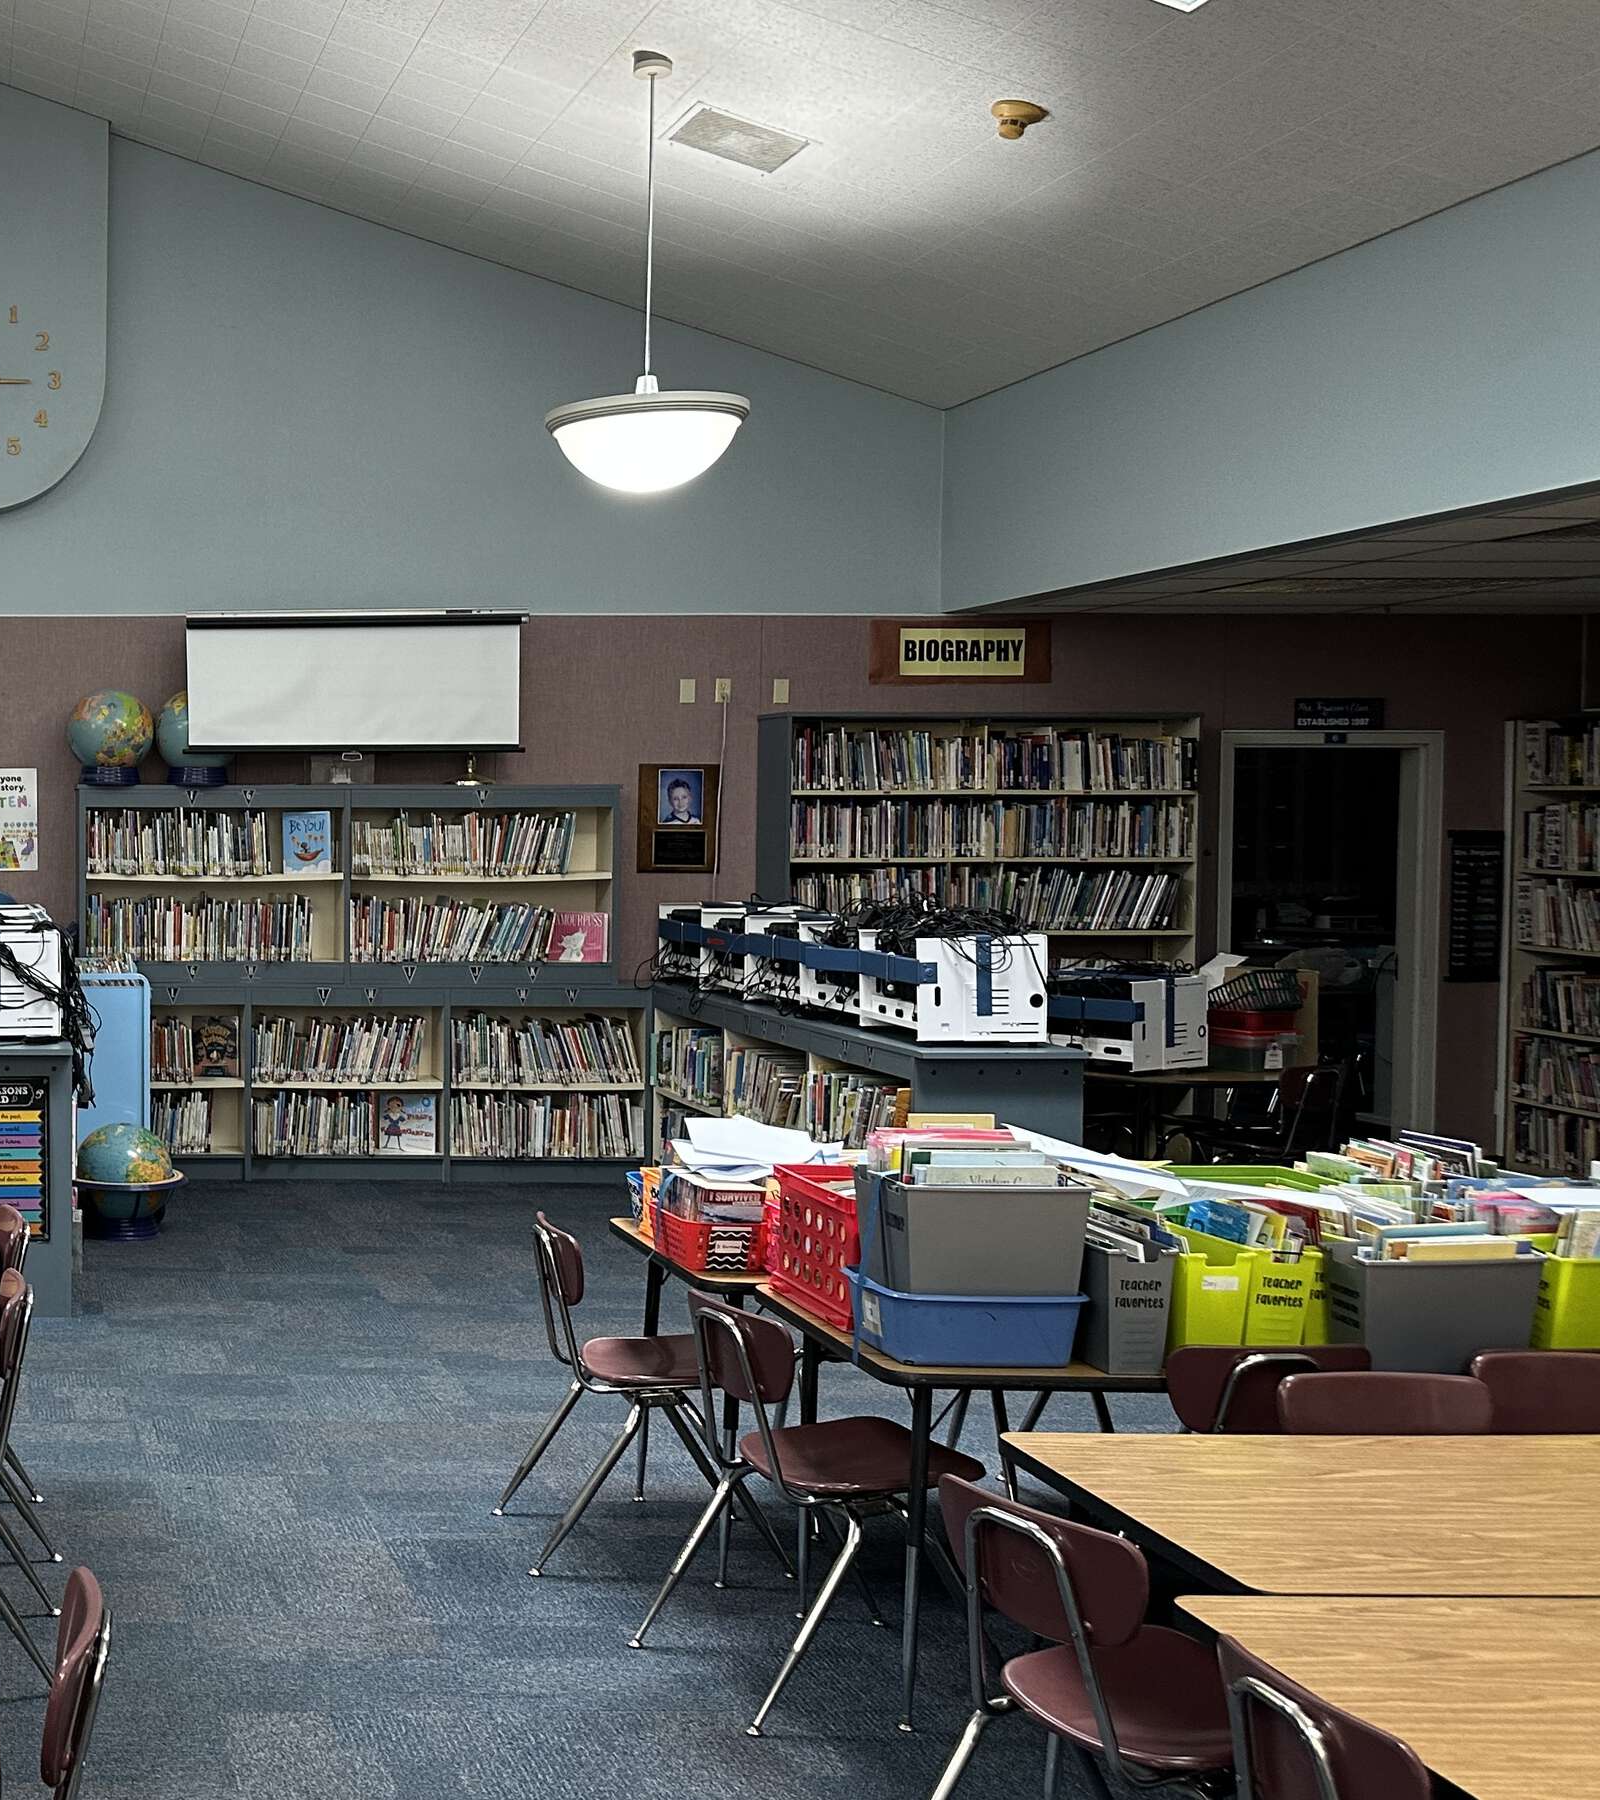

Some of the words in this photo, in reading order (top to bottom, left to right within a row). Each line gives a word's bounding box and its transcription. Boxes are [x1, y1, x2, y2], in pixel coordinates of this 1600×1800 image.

[8, 305, 19, 324] 1
[34, 331, 50, 352] 2
[47, 370, 62, 390] 3
[33, 409, 49, 428] 4
[6, 436, 22, 455] 5
[904, 639, 1023, 661] BIOGRAPHY
[0, 784, 26, 792] story.
[556, 913, 603, 927] AMOURPUSS
[715, 1192, 761, 1202] SURVIVED
[1120, 1279, 1162, 1291] Teacher
[1262, 1276, 1302, 1290] Teacher
[1115, 1296, 1164, 1309] Favorites
[1256, 1293, 1304, 1308] Favorites
